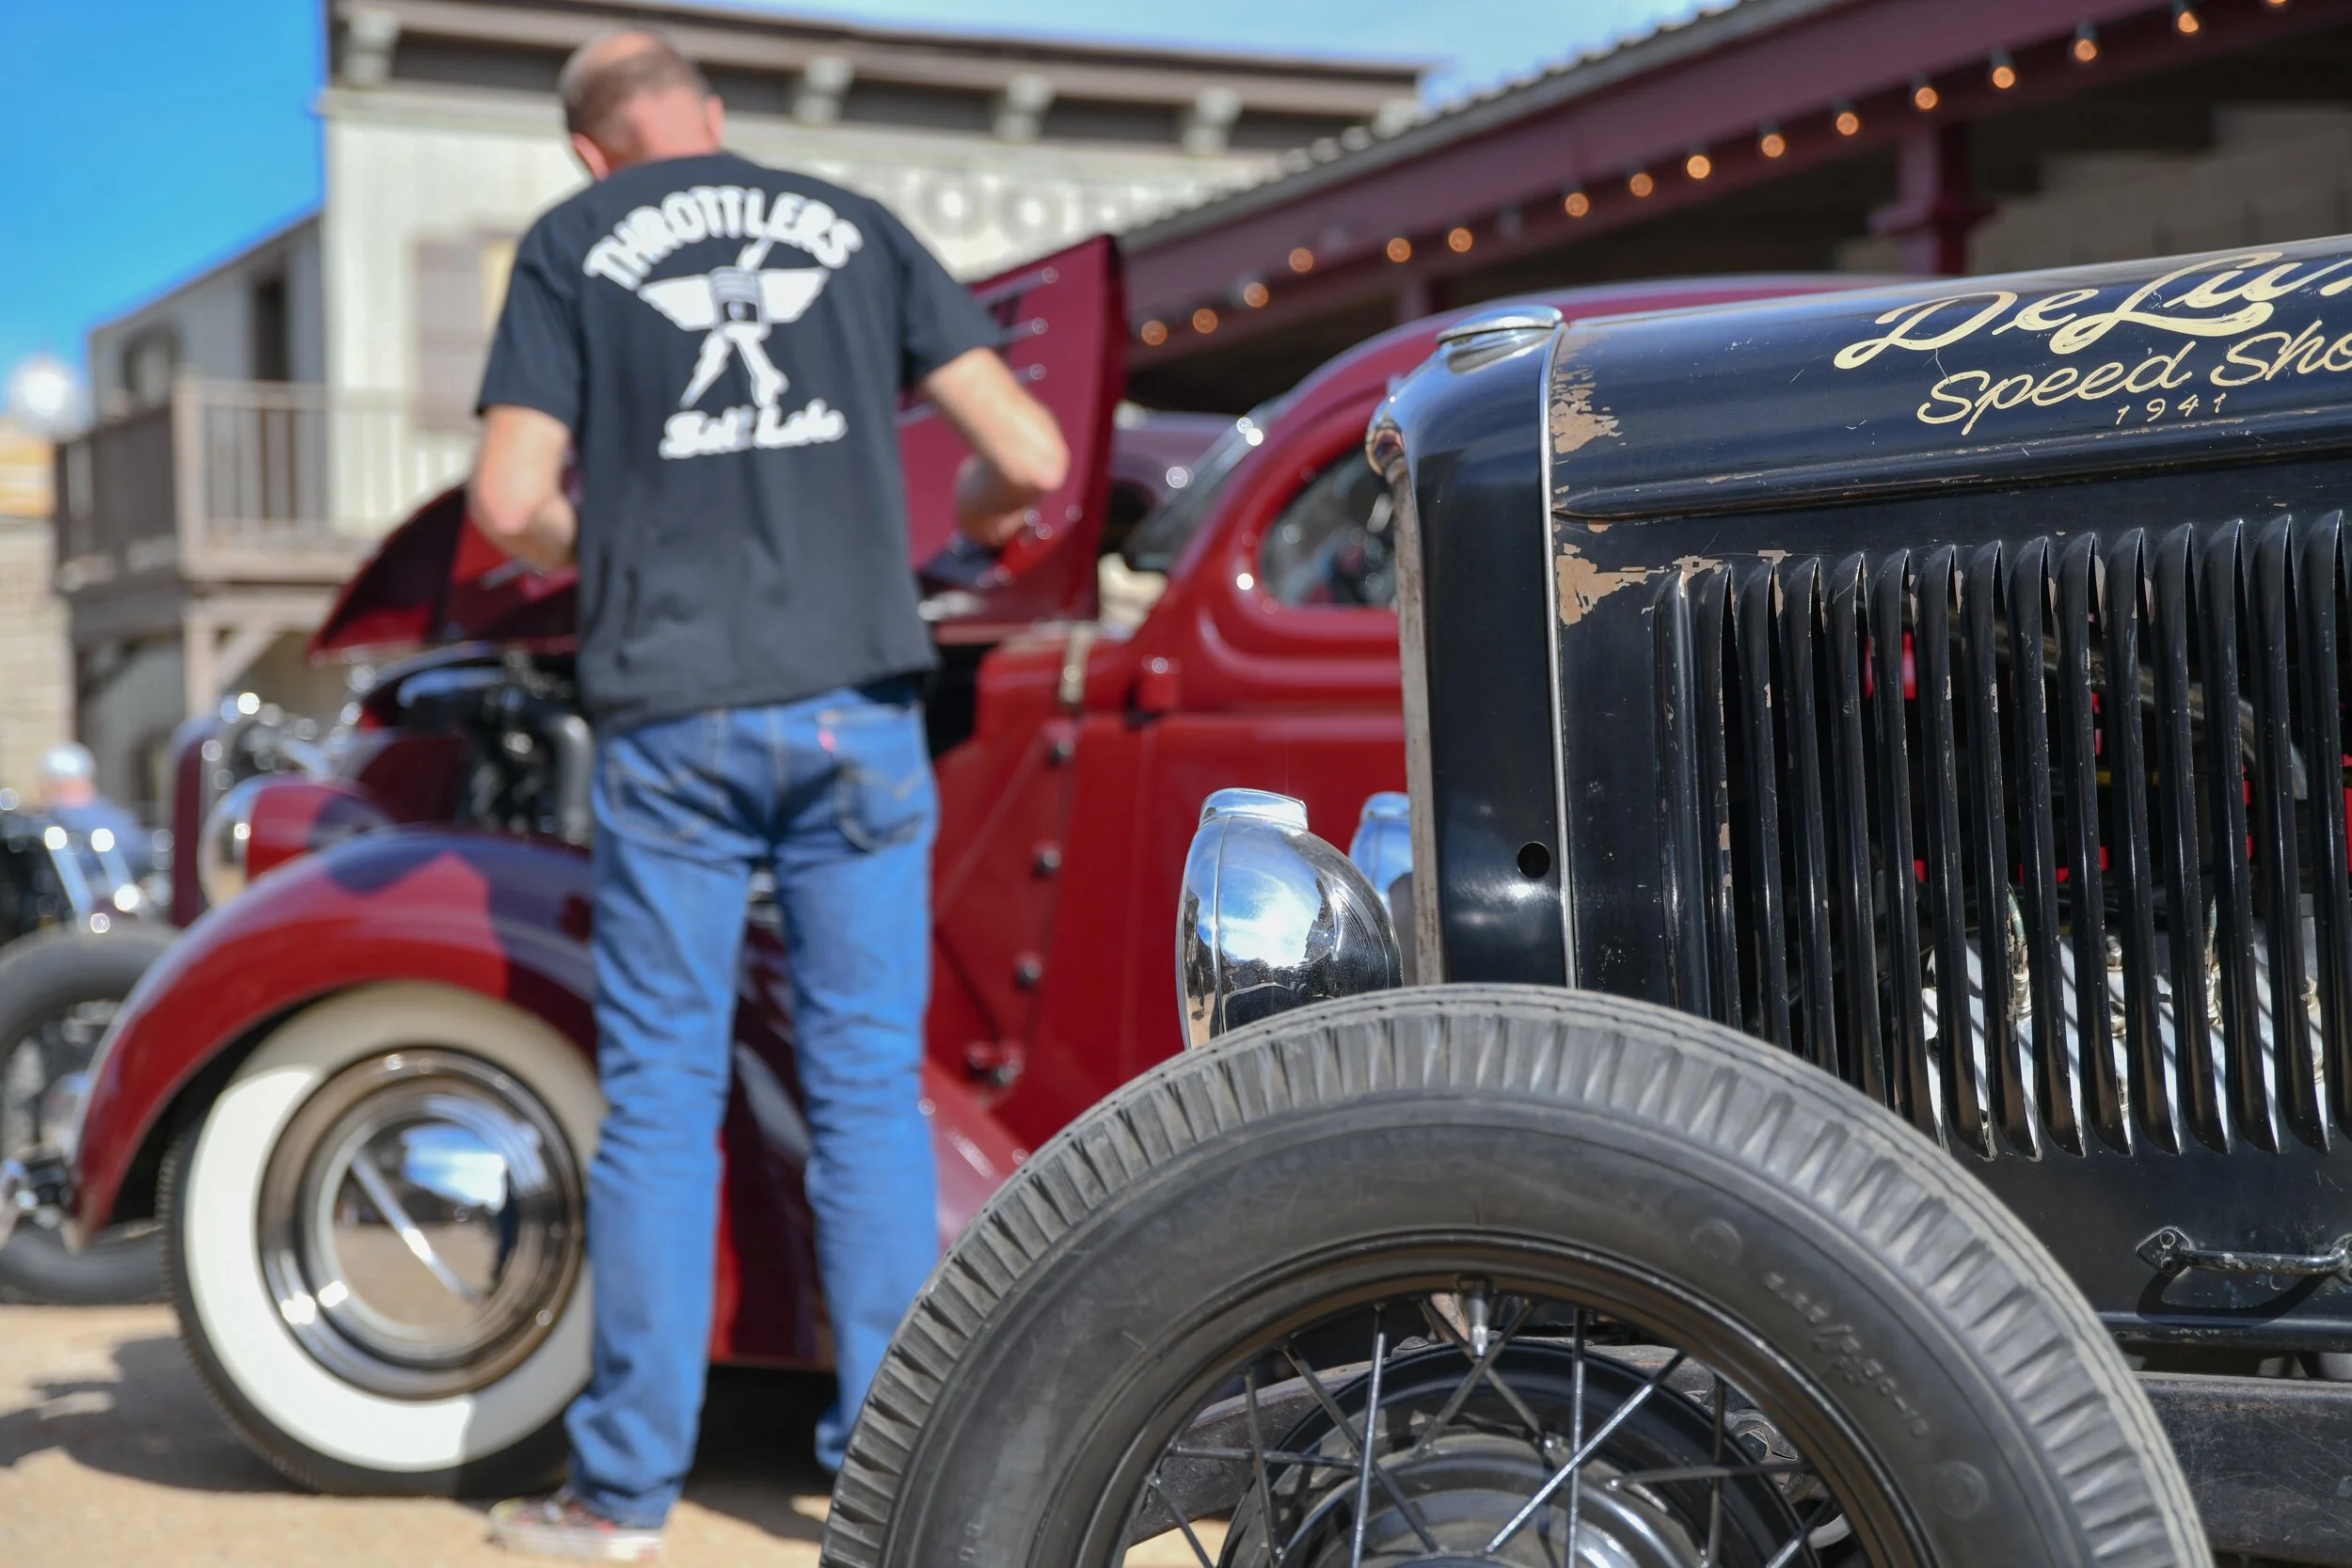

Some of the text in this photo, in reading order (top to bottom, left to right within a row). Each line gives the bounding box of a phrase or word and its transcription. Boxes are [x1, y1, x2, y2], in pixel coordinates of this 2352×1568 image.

[582, 185, 864, 290] THROTTLERS
[1916, 341, 2197, 436] Speed
[2115, 392, 2227, 425] 1941
